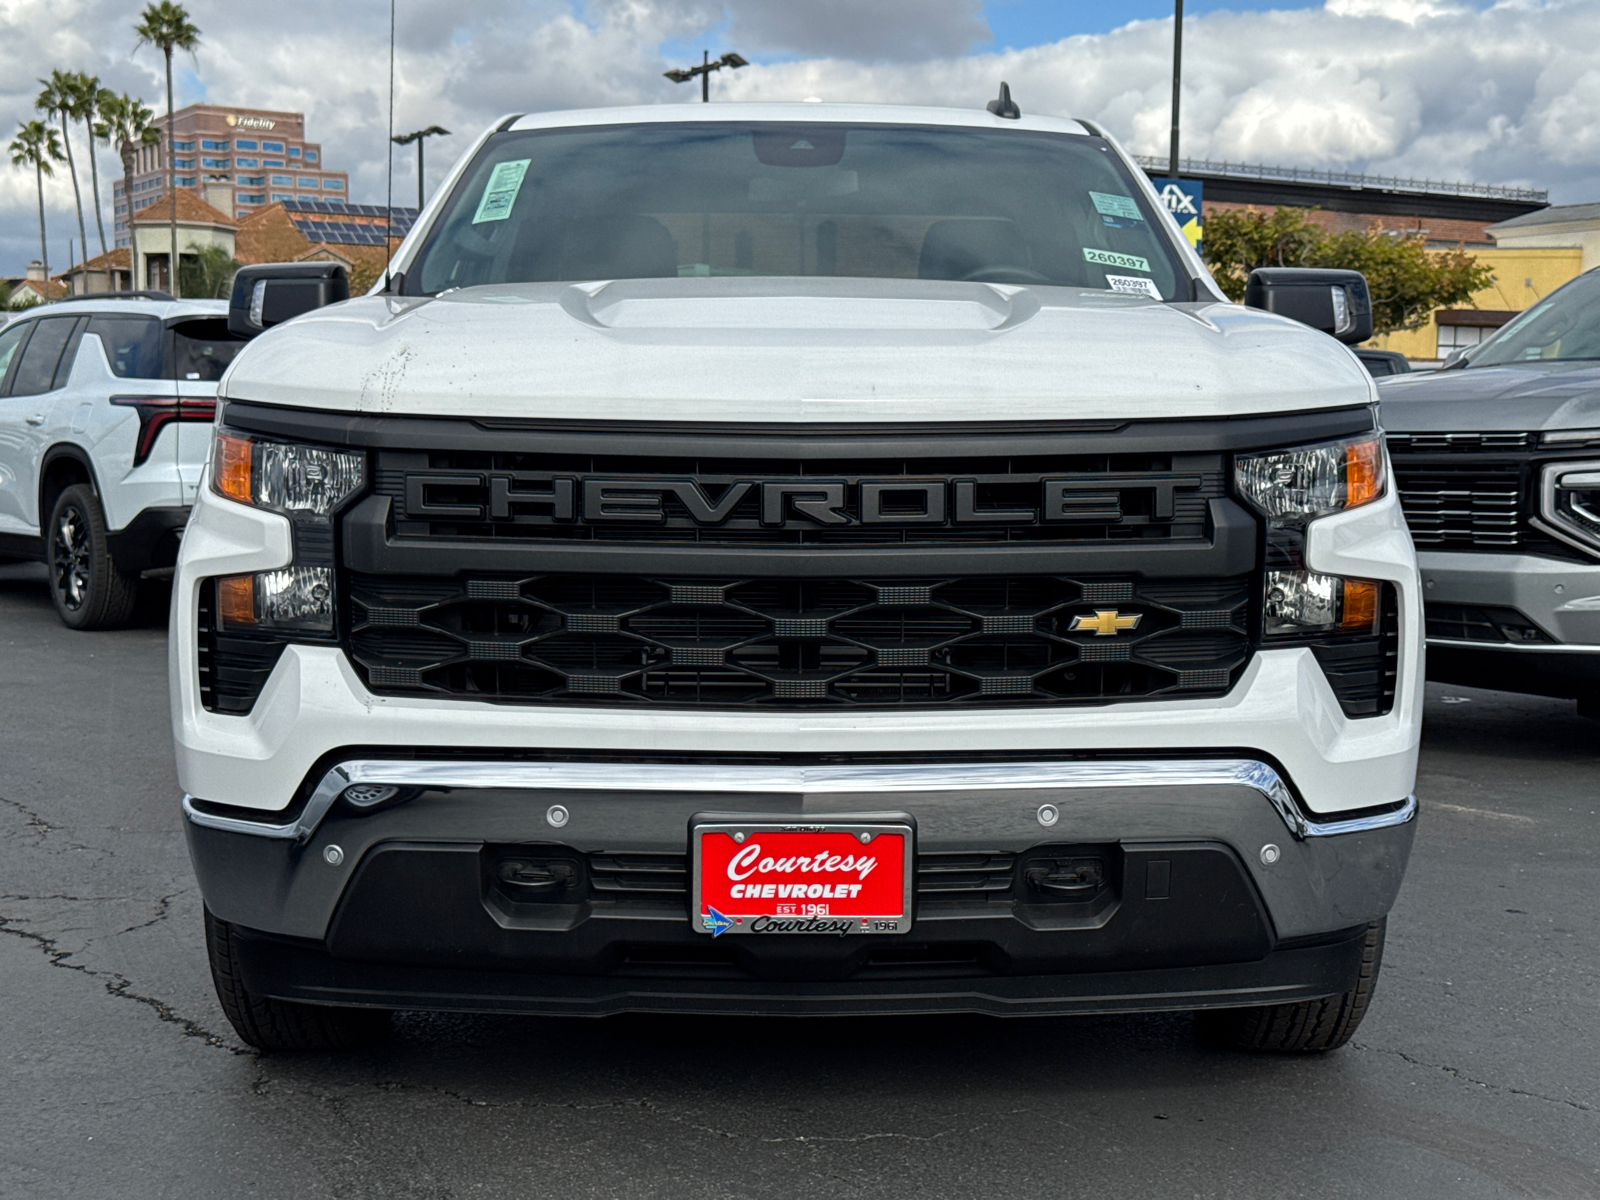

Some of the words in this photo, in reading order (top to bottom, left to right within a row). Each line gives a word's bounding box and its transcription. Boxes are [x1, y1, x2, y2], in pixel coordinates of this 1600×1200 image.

[237, 116, 275, 130] Fidelity
[1160, 184, 1198, 214] fix
[1087, 251, 1145, 269] 260397
[1110, 278, 1148, 288] 260397
[404, 472, 1203, 527] CHEVROLET
[727, 843, 878, 881] Courtesy
[730, 884, 863, 899] CHEVROLET
[777, 906, 797, 914] EST
[800, 904, 829, 915] 1961
[750, 915, 854, 937] Courtesy
[873, 921, 898, 931] 1961
